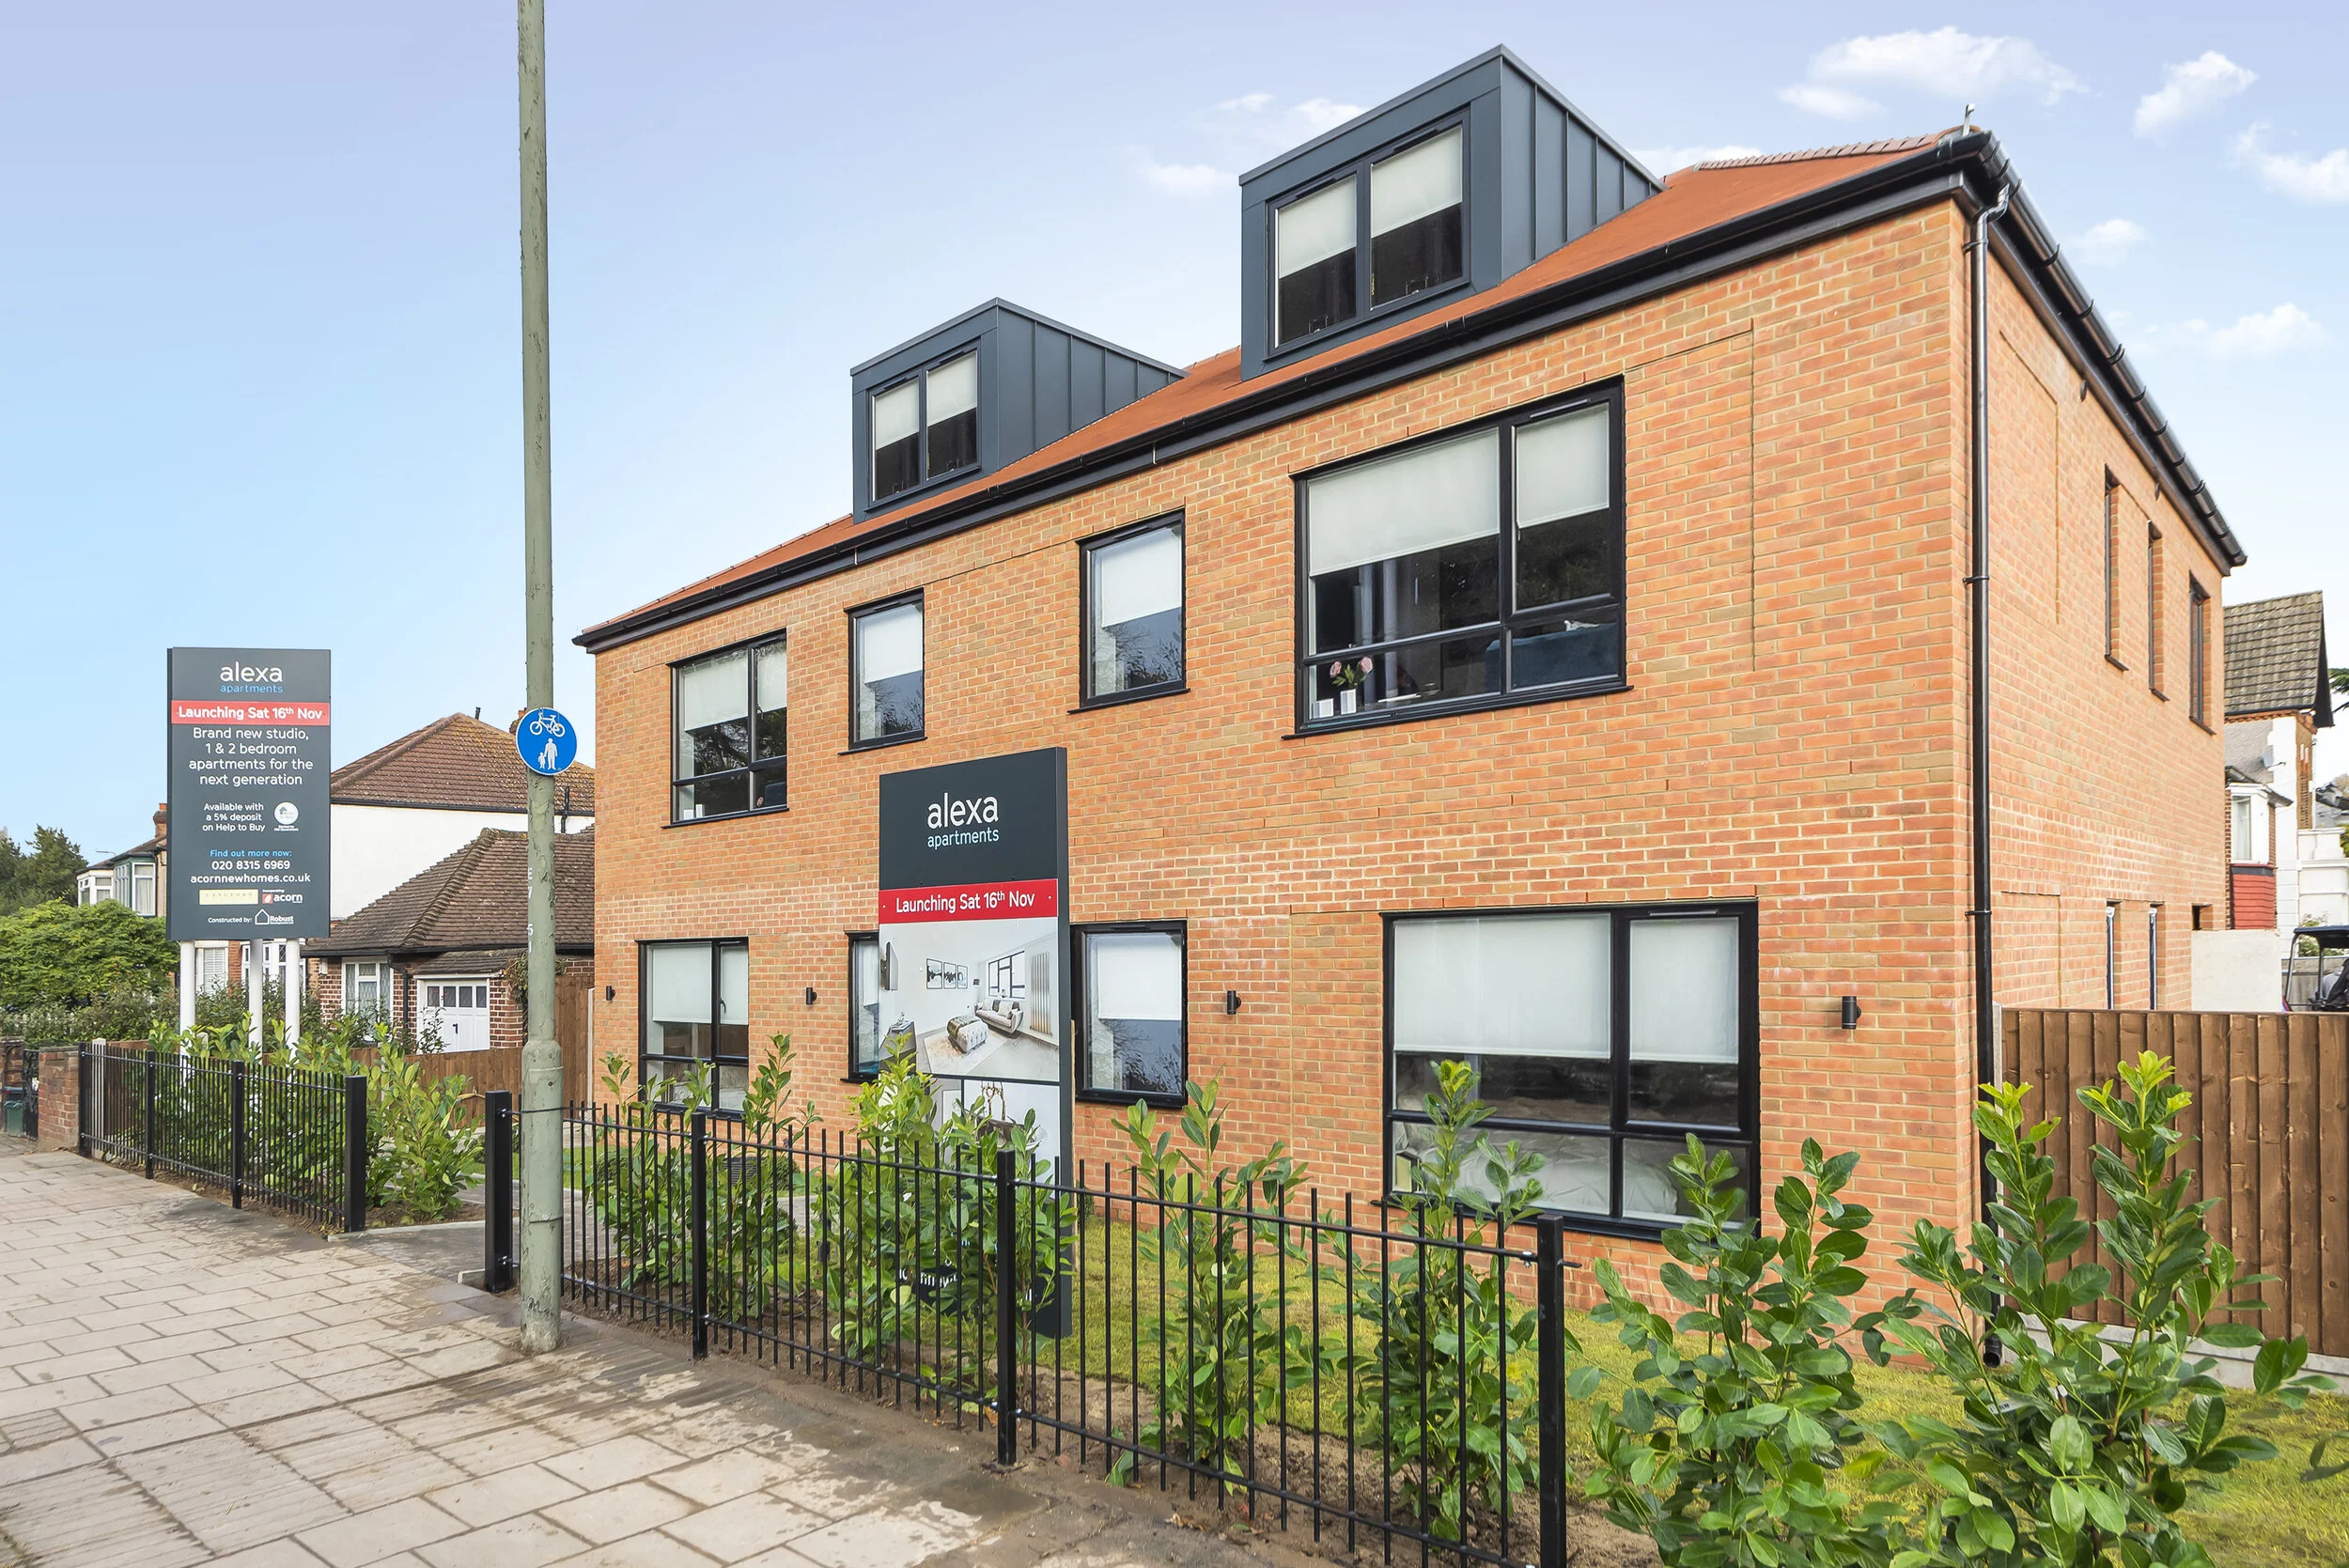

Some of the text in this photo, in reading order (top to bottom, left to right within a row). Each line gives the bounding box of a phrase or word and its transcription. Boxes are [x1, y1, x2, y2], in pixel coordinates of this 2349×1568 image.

[220, 660, 283, 683] alexa
[220, 684, 284, 694] apartments
[178, 706, 323, 721] Launching Sat 16th Nov
[193, 727, 309, 740] Brand new studio,
[205, 742, 297, 754] 1 & 2 bedroom
[188, 758, 314, 771] apartments for the
[199, 773, 303, 787] next generation
[203, 802, 264, 812] Available with
[926, 792, 1000, 830] alexa
[213, 813, 228, 822] 5%
[229, 813, 263, 823] deposit
[215, 823, 237, 832] Help
[237, 823, 247, 831] to
[249, 823, 266, 832] Buy
[926, 827, 1000, 850] apartments
[210, 849, 228, 858] Find
[230, 849, 244, 858] out
[211, 860, 291, 871] 020 8315 6969
[190, 873, 311, 884] acornnewhomes.co.uk
[272, 893, 303, 903] acorn
[895, 890, 1035, 914] Launching Sat 16th Nov
